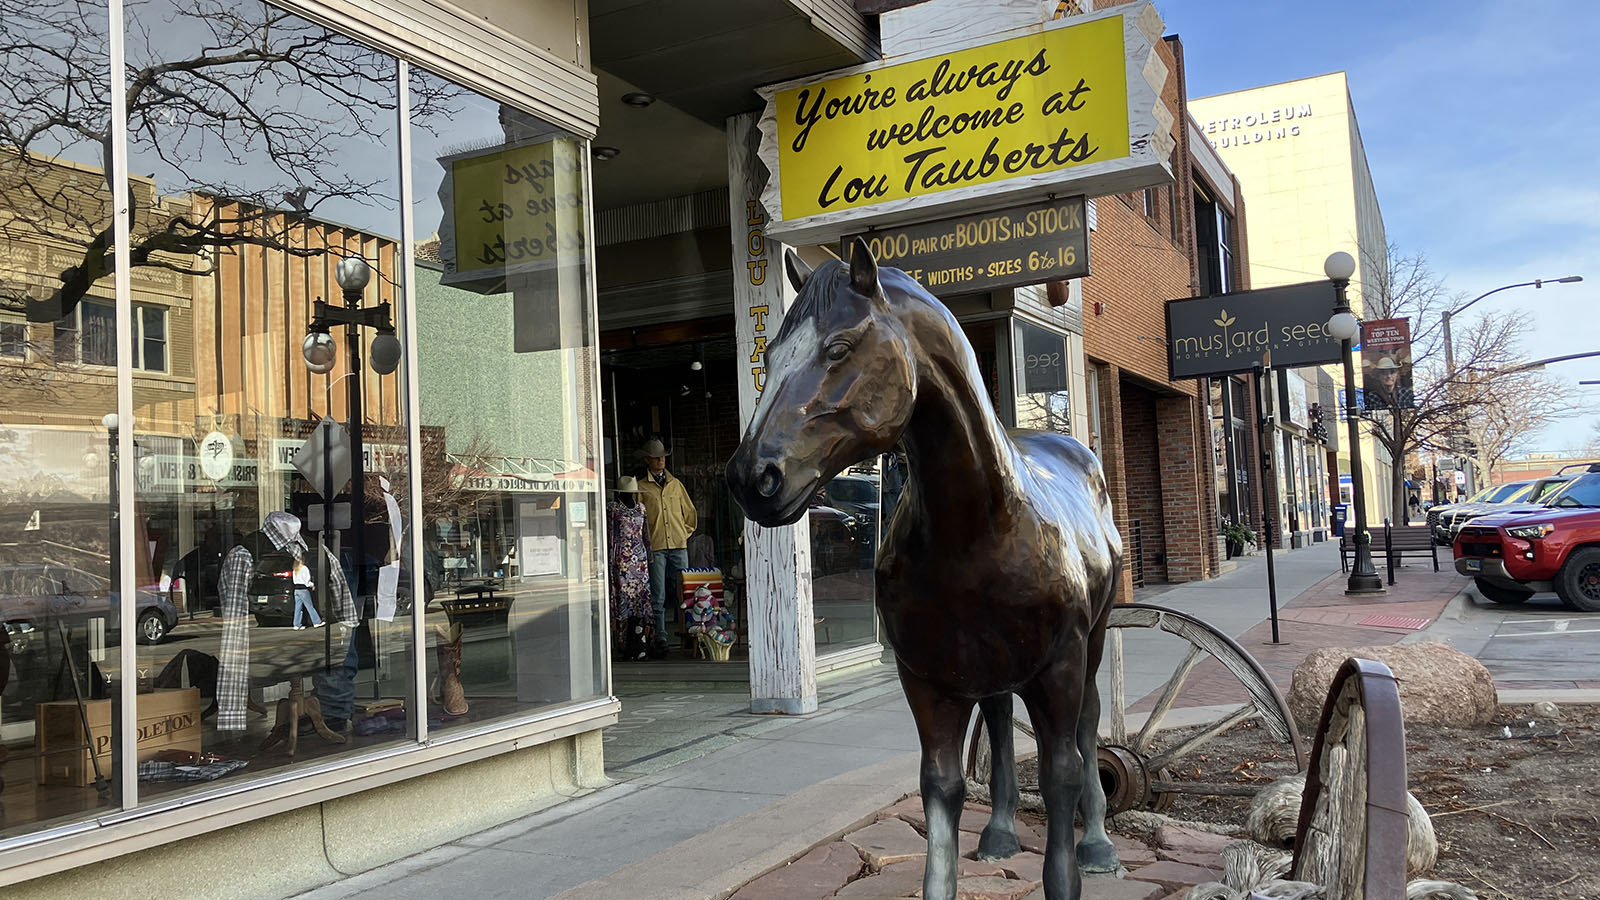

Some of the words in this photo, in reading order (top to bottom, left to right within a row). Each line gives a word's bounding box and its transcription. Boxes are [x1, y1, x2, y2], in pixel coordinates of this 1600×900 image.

[792, 74, 897, 152] You're
[905, 48, 1051, 101] always
[866, 105, 1025, 151] welcome
[1042, 78, 1091, 116] at
[818, 165, 889, 208] Lou
[904, 127, 1099, 193] Tauberts
[747, 200, 768, 286] LOU
[912, 237, 938, 255] PAIR
[940, 233, 955, 251] OF
[956, 216, 1011, 248] BOOTS
[1013, 222, 1024, 239] IN
[1026, 204, 1081, 236] STOCK
[927, 266, 973, 286] WIDTHS
[987, 258, 1022, 277] SIZES
[1028, 251, 1040, 271] 6
[1040, 250, 1057, 269] to
[1058, 246, 1076, 266] 16
[750, 305, 769, 405] TAU
[1176, 318, 1269, 356] mustard
[1176, 351, 1209, 360] HOME
[96, 713, 193, 755] PDLETON
